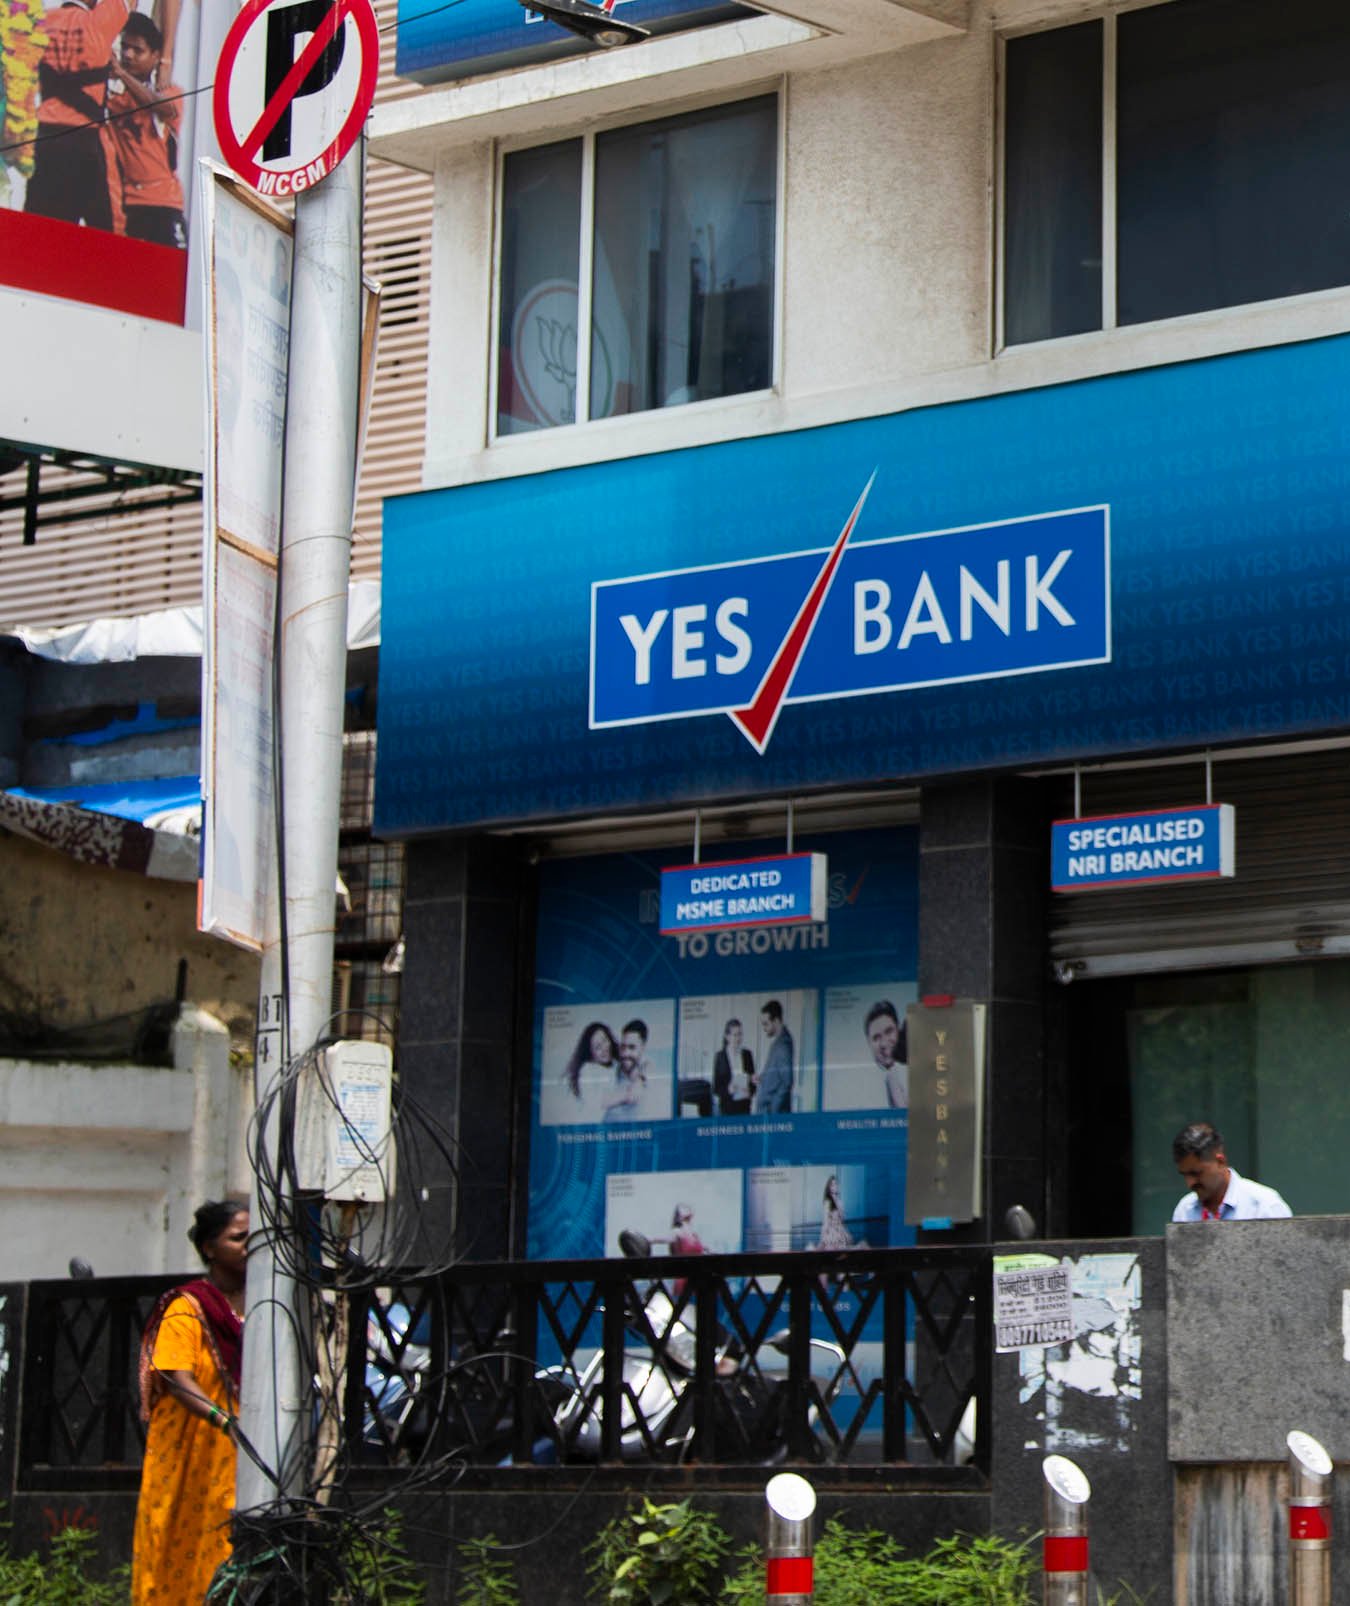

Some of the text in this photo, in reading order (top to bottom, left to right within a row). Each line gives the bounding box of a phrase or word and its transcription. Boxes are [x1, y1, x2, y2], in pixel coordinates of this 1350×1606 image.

[263, 0, 346, 162] P
[256, 160, 328, 196] MCGM
[619, 549, 1077, 685] YES BANK
[1068, 817, 1205, 852] SPECIALISED
[1068, 845, 1204, 877] NRI BRANCH
[690, 870, 782, 895] DEDICATED
[676, 897, 725, 920] MSME
[728, 893, 795, 915] BRANCH
[676, 924, 830, 959] TO GROWTH
[697, 1126, 745, 1137] BUSINESS
